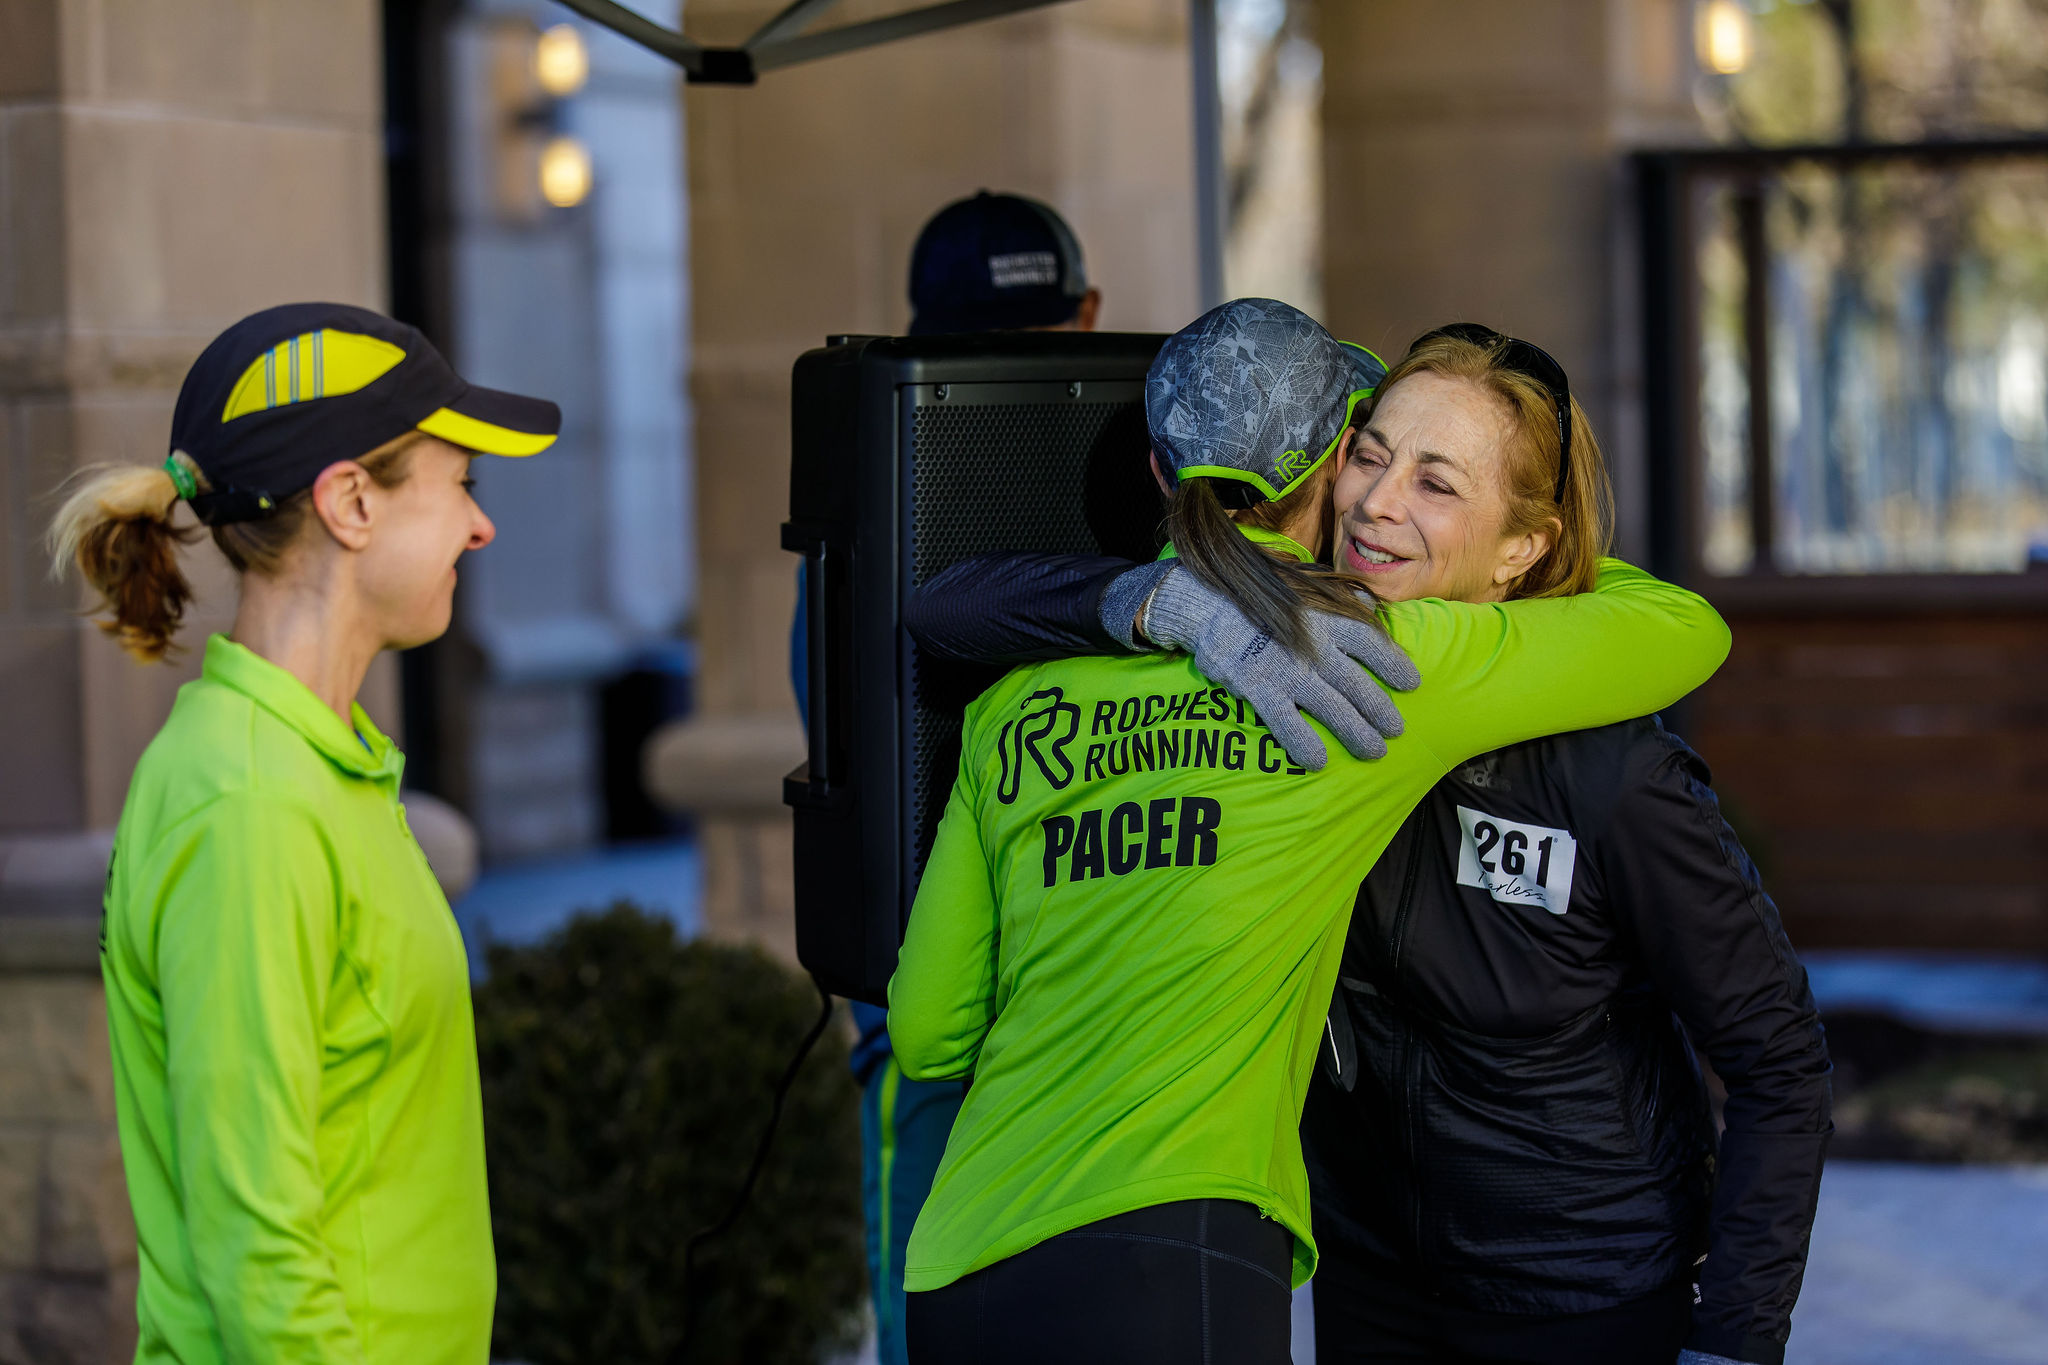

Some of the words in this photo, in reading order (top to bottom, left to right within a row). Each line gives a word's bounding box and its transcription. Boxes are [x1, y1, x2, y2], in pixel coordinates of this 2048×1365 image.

[1091, 687, 1266, 736] ROCHEST
[1085, 729, 1246, 782] RUNNING
[1258, 733, 1305, 775] C
[1041, 797, 1221, 888] PACER
[1474, 820, 1553, 889] 261
